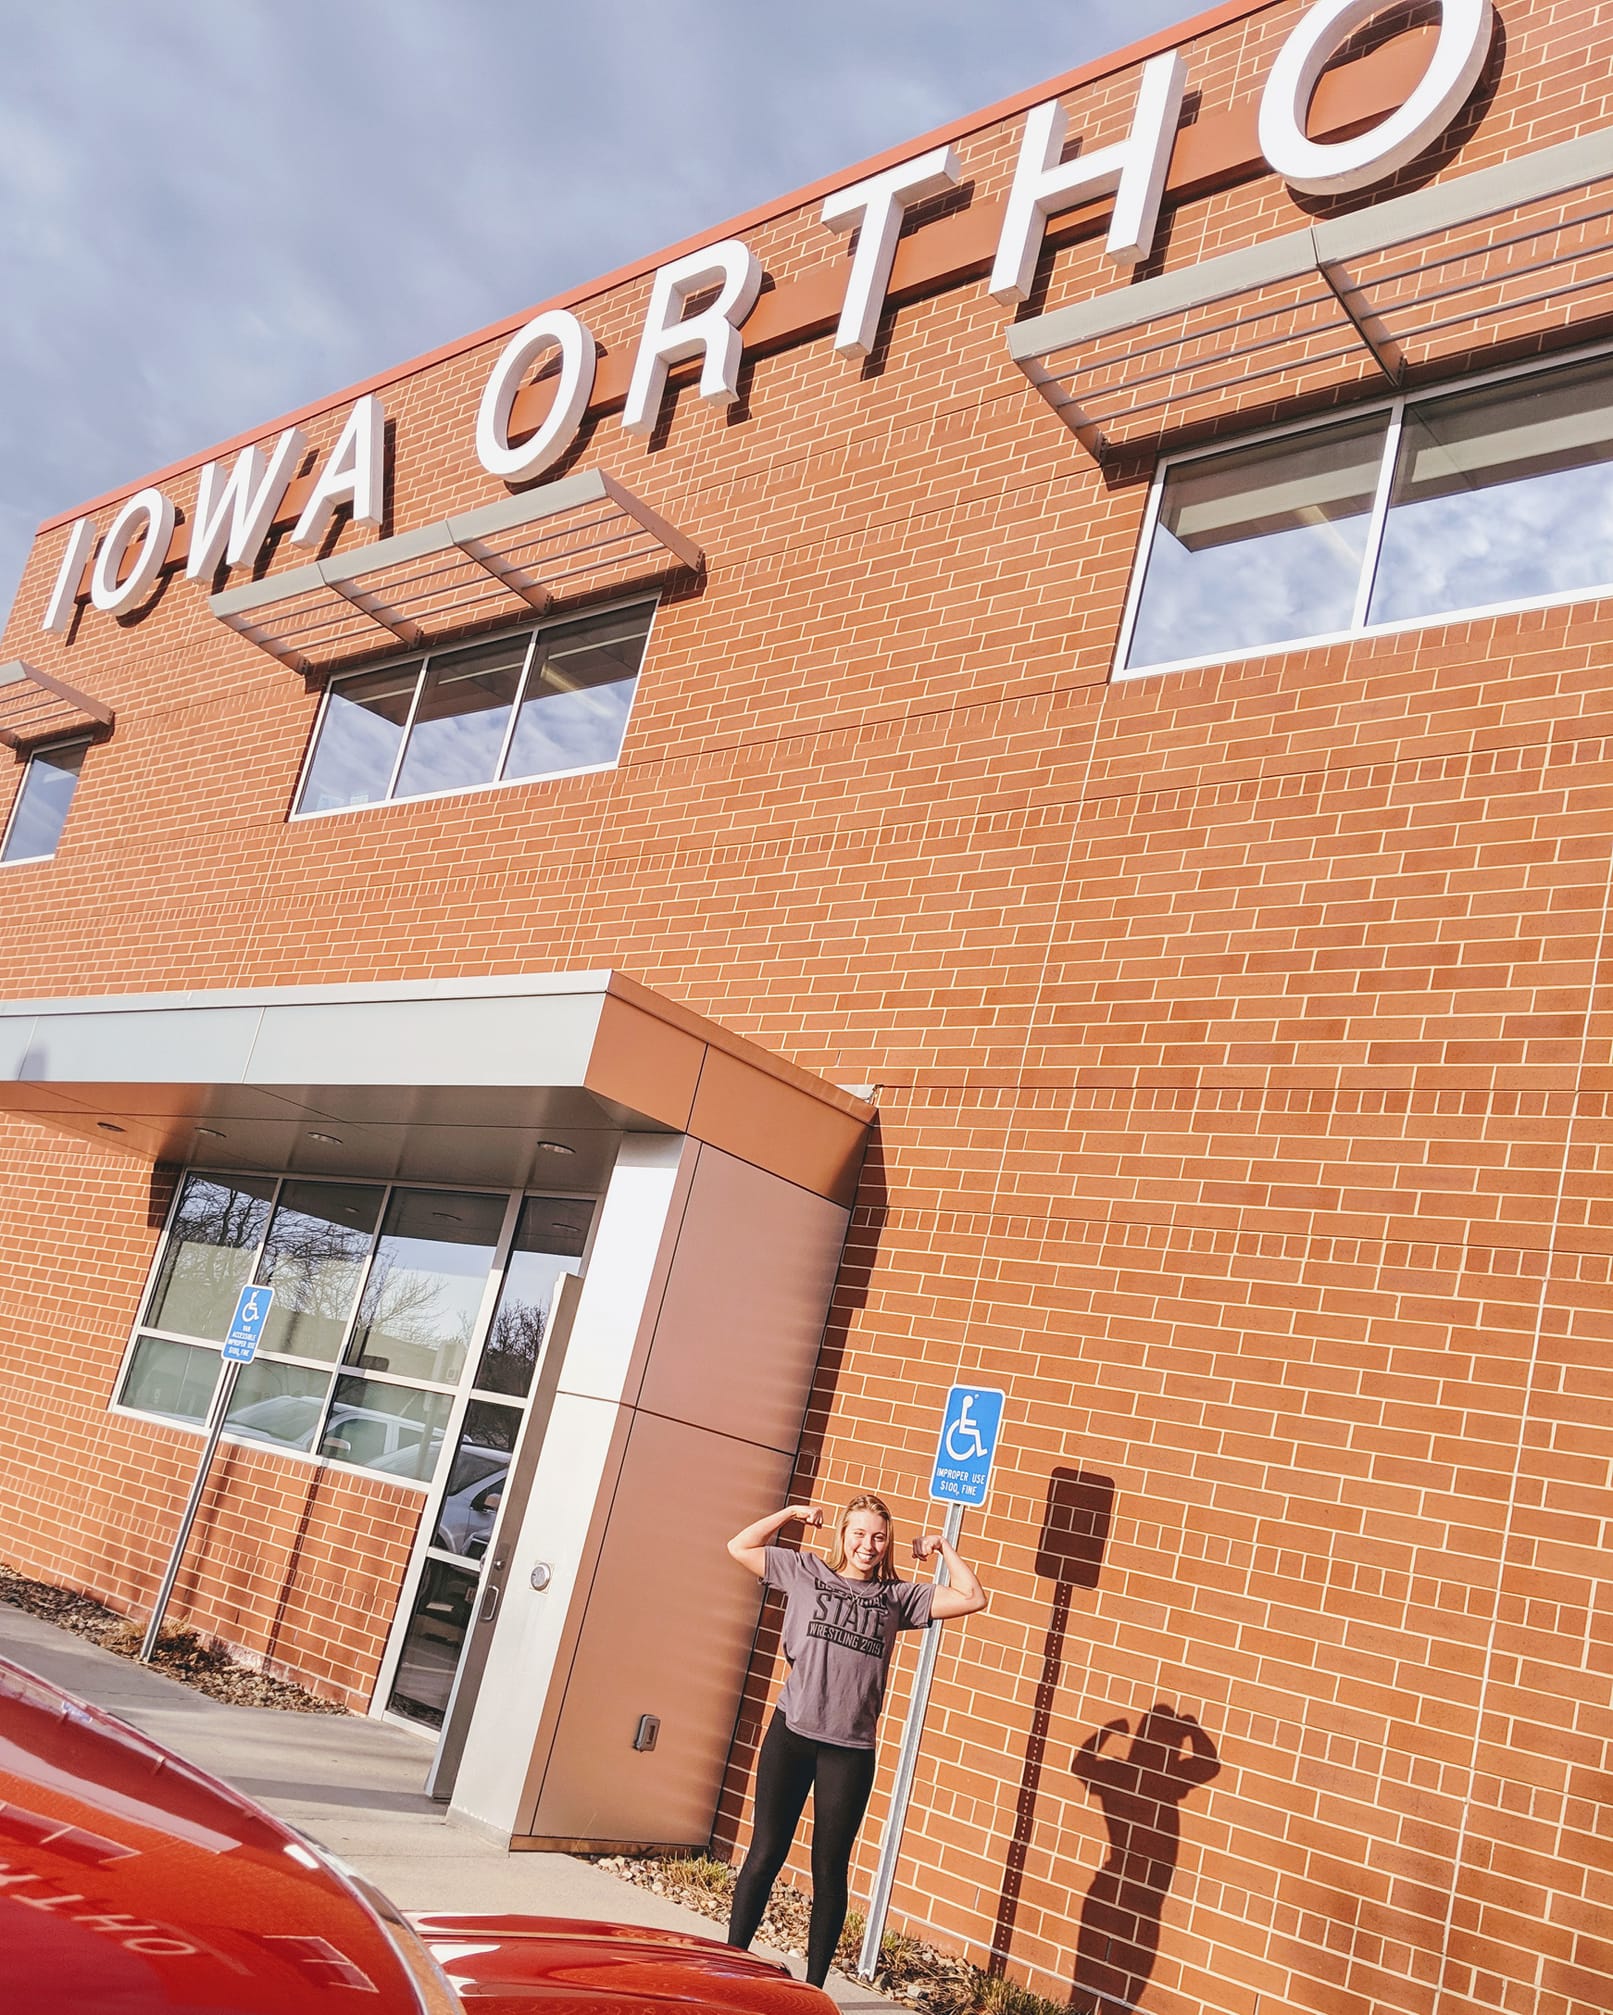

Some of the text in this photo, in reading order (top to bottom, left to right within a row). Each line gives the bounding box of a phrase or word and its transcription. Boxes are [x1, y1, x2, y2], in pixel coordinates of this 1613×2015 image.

[42, 0, 1494, 633] IOWA ORTHO
[936, 1467, 986, 1484] IMPROPER USE
[961, 1485, 977, 1496] FINE
[813, 1592, 886, 1640] STATE
[809, 1623, 881, 1656] WRESTLING 2019
